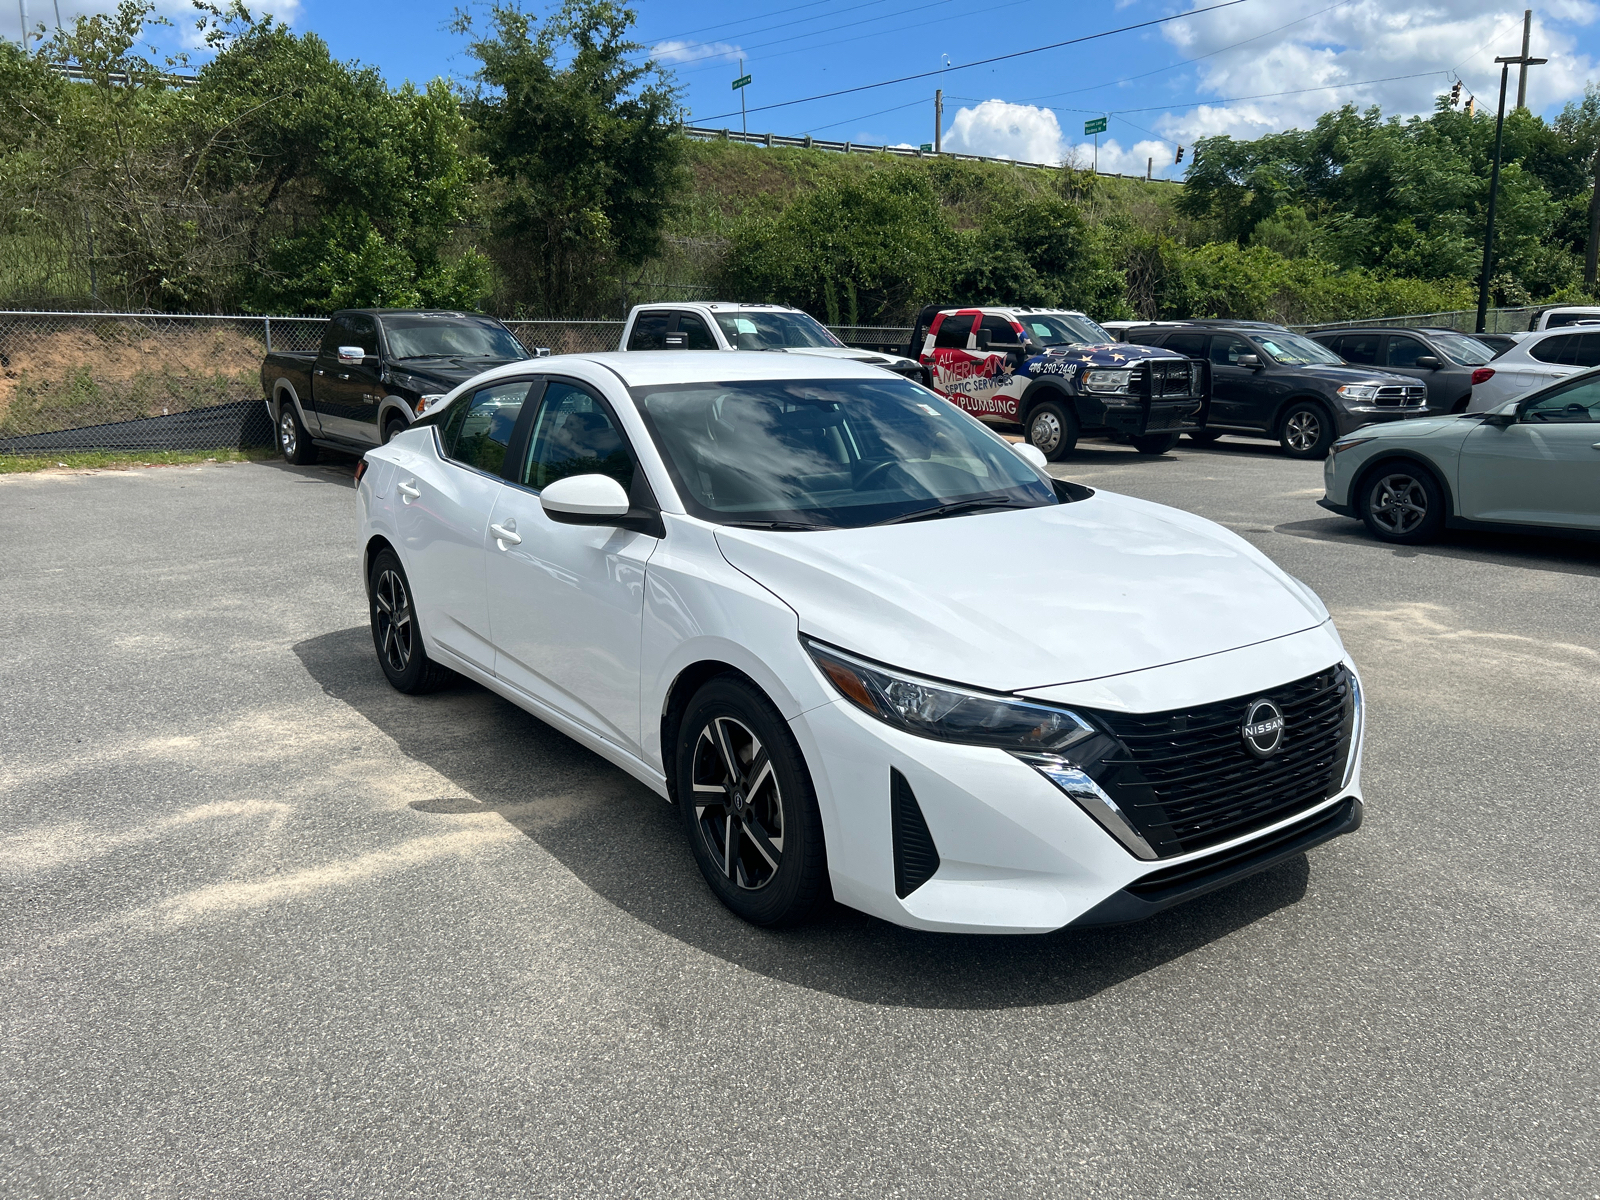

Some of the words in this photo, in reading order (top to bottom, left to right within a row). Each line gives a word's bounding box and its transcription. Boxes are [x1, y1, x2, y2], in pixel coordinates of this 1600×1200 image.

[939, 351, 953, 365] ALL
[945, 381, 972, 396] SEPTIC
[973, 375, 1014, 392] SERVICES
[1245, 718, 1284, 737] NISSAN
